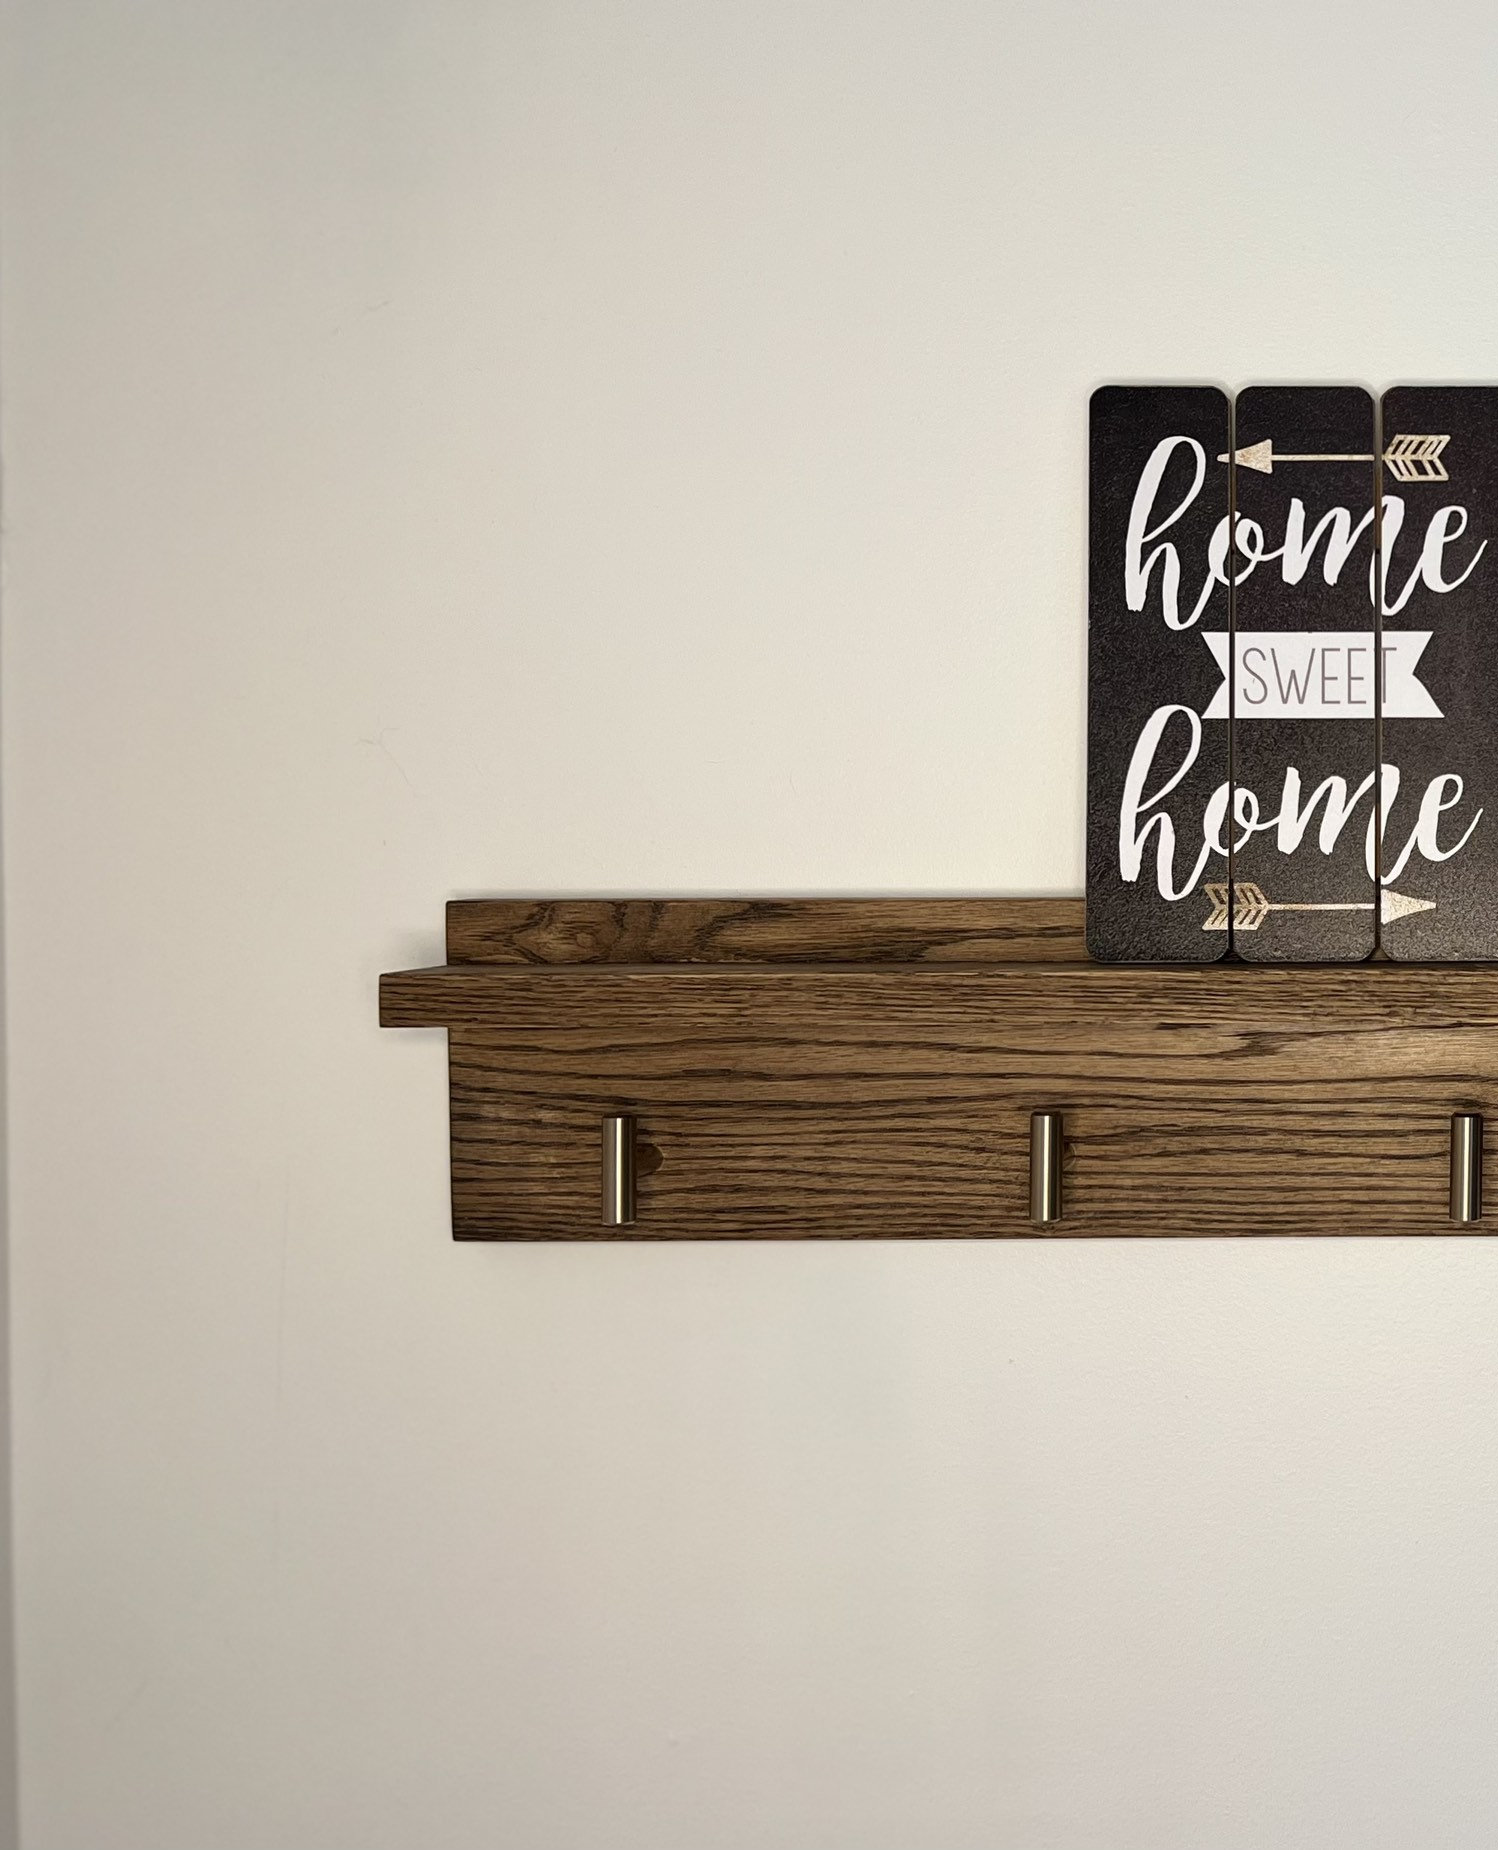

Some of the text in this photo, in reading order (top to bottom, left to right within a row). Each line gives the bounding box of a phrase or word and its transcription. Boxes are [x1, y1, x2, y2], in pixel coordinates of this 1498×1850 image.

[1124, 435, 1488, 631] home
[1241, 646, 1398, 706] SWEET
[1118, 704, 1484, 902] home
